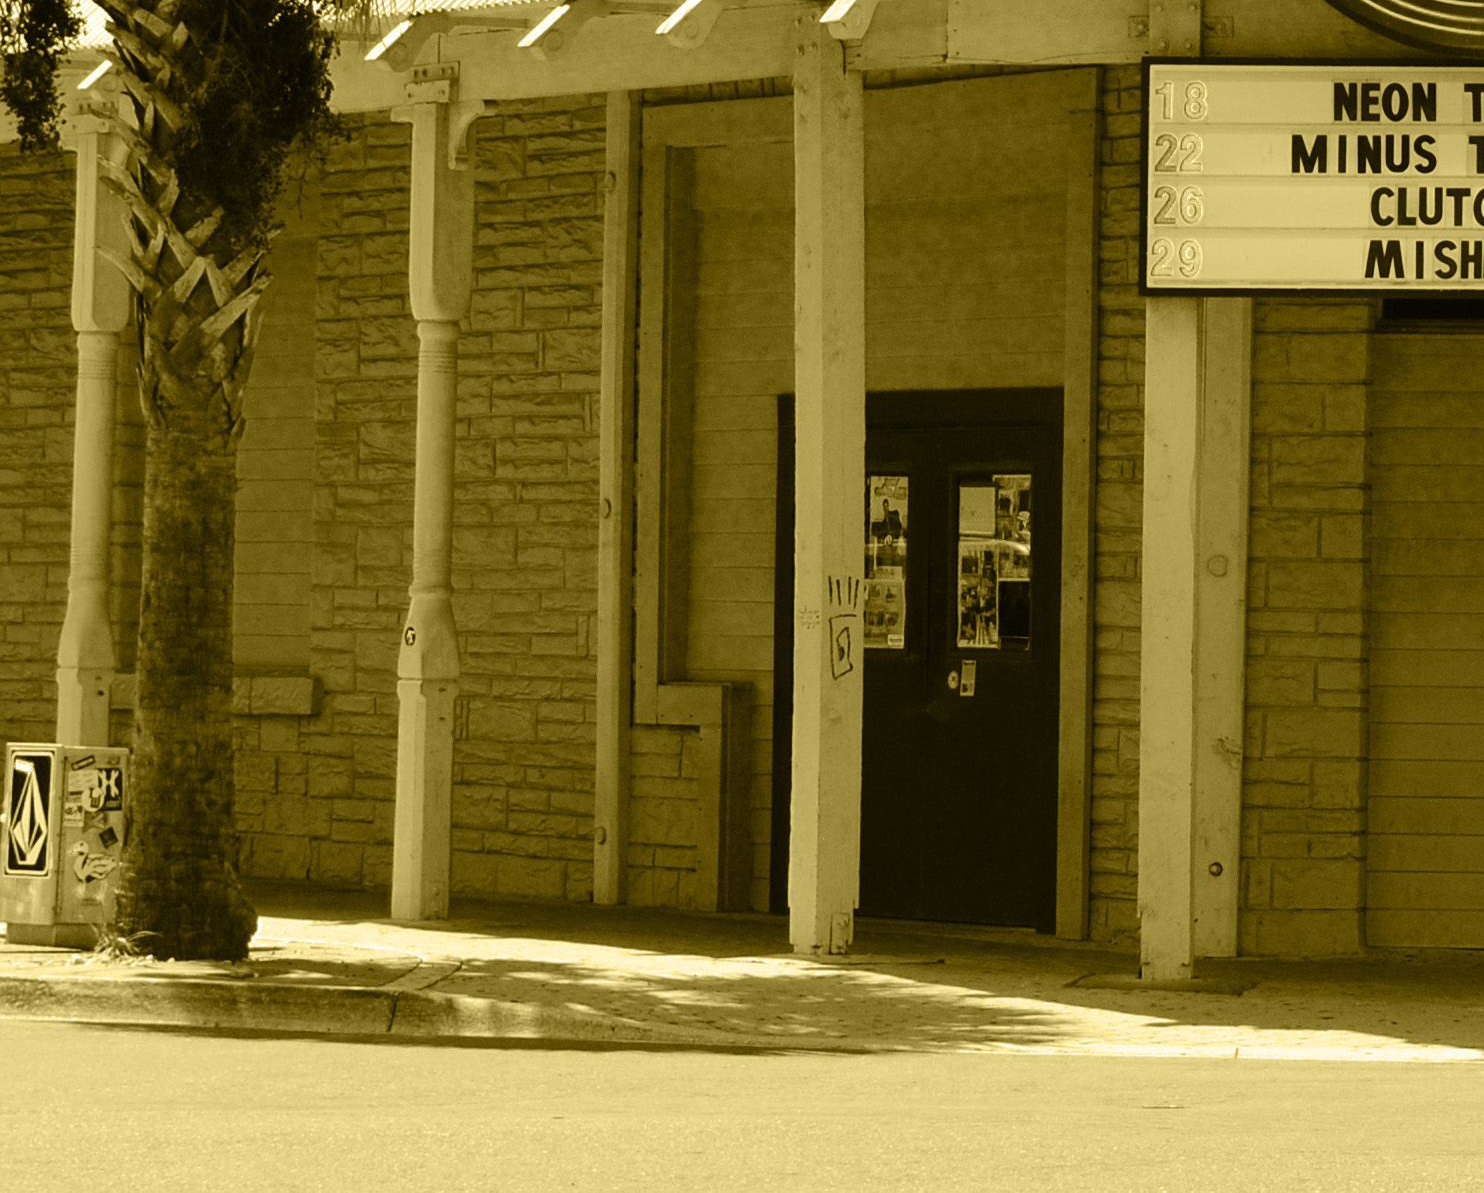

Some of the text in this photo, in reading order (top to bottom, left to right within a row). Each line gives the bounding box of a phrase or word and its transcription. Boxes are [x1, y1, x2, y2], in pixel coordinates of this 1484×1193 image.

[1154, 80, 1209, 121] 18
[1333, 82, 1437, 122] NEON
[1153, 133, 1204, 173] 22
[1291, 134, 1438, 174] MINUS
[1153, 185, 1204, 225] 26
[1150, 238, 1204, 278] 29
